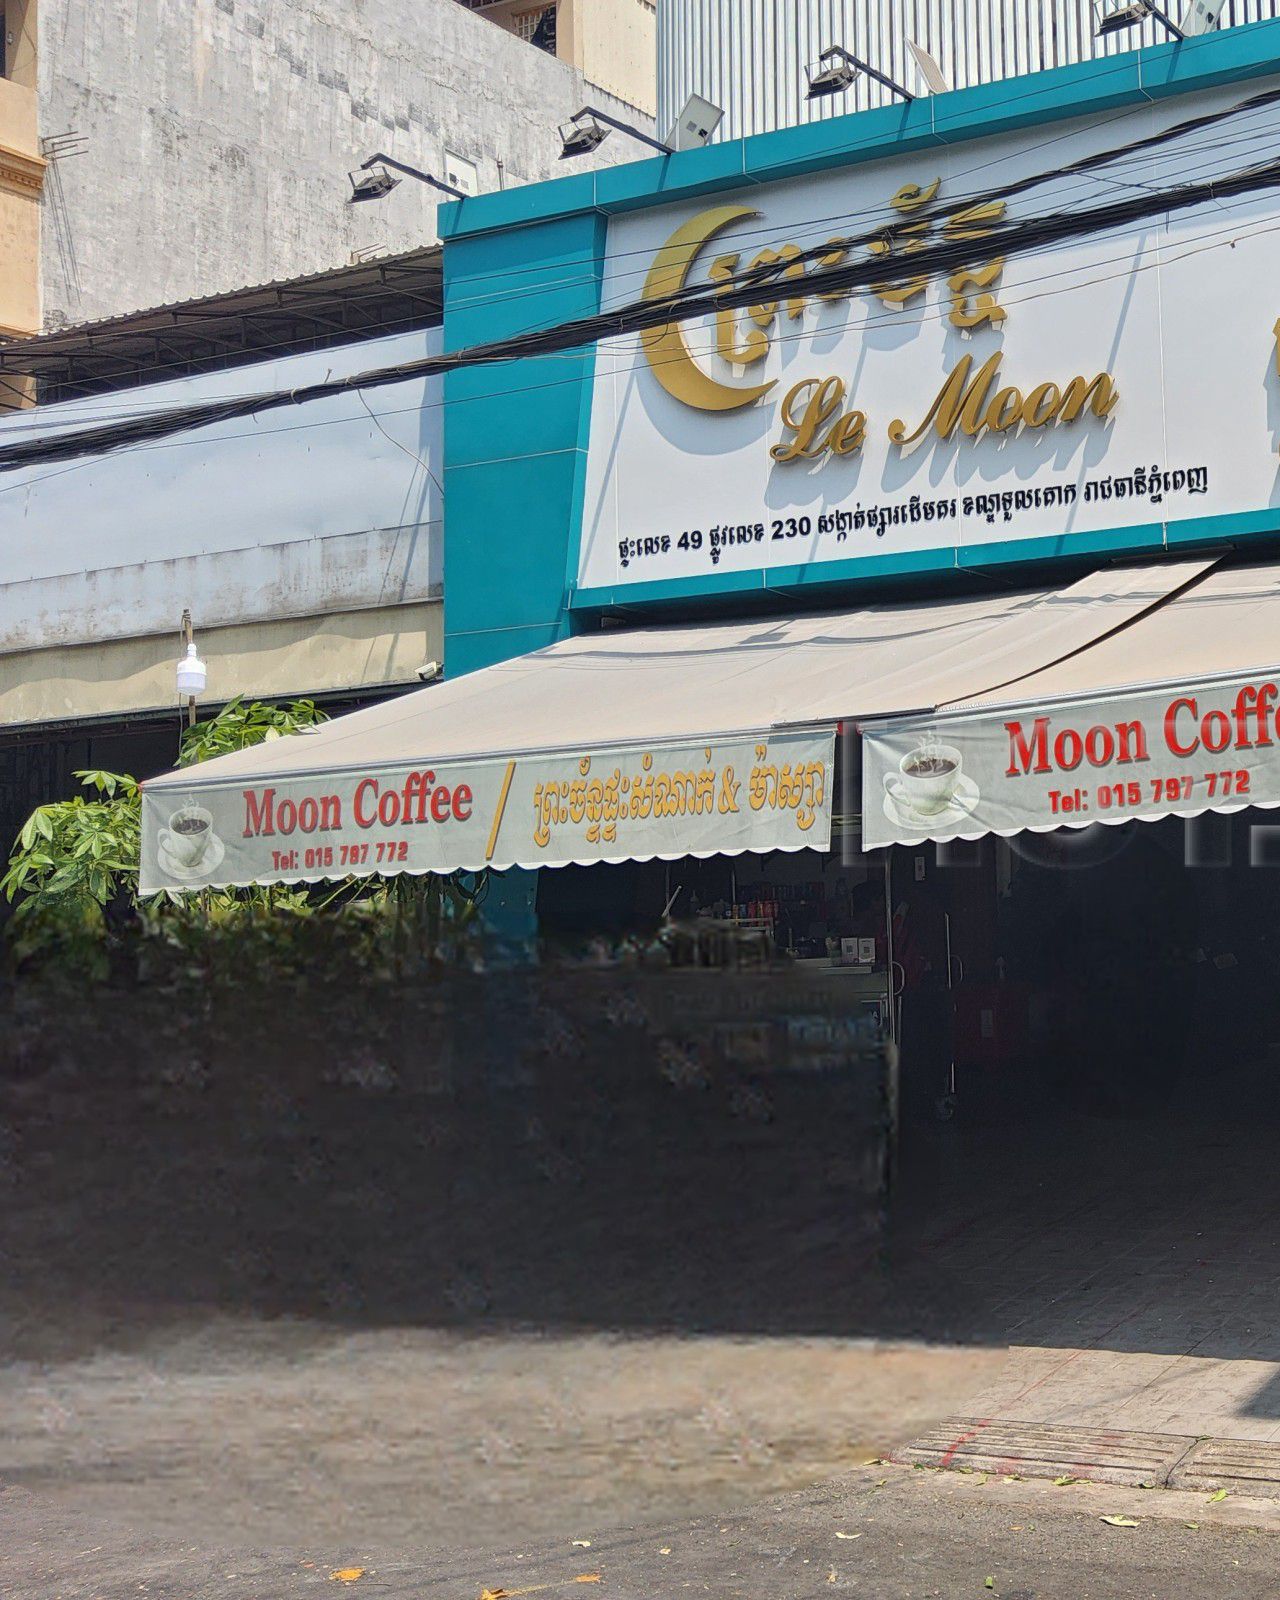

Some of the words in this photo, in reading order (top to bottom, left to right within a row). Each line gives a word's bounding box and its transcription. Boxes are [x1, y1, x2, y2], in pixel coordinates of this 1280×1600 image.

[770, 375, 867, 463] Le
[887, 350, 1120, 446] Moon
[677, 530, 703, 551] 49
[771, 516, 812, 540] 230
[1004, 716, 1149, 778] Moon
[242, 787, 343, 837] Moon
[354, 770, 473, 828] Coffee
[718, 764, 741, 814] &
[1048, 789, 1088, 814] Tel:
[1097, 782, 1142, 809] 015
[1150, 776, 1193, 804] 797
[1205, 769, 1250, 798] 772
[272, 850, 299, 871] Tel:
[305, 847, 333, 868] 015
[376, 841, 408, 862] 772
